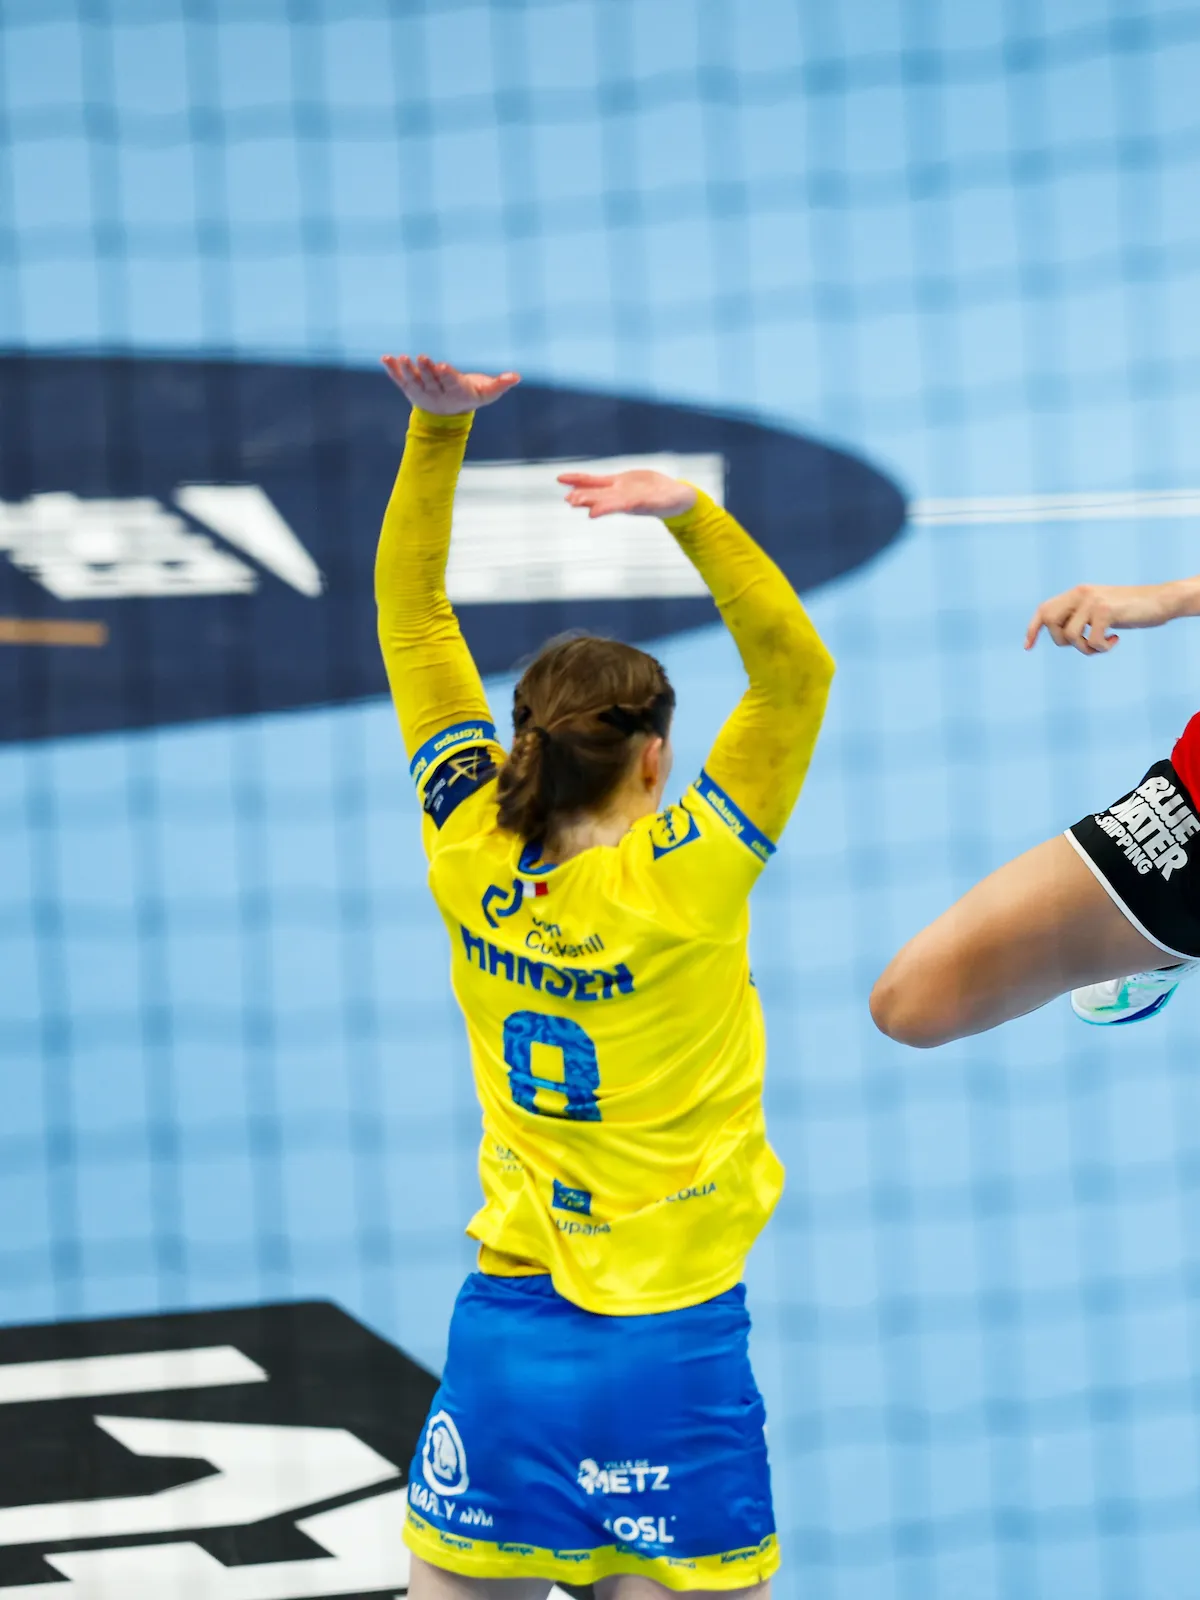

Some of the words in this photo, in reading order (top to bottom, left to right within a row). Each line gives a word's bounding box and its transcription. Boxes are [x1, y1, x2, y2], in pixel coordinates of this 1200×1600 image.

[1094, 813, 1153, 875] SHIPPING
[1109, 792, 1188, 881] WATER
[503, 1010, 602, 1122] 8
[594, 1466, 670, 1494] METZ
